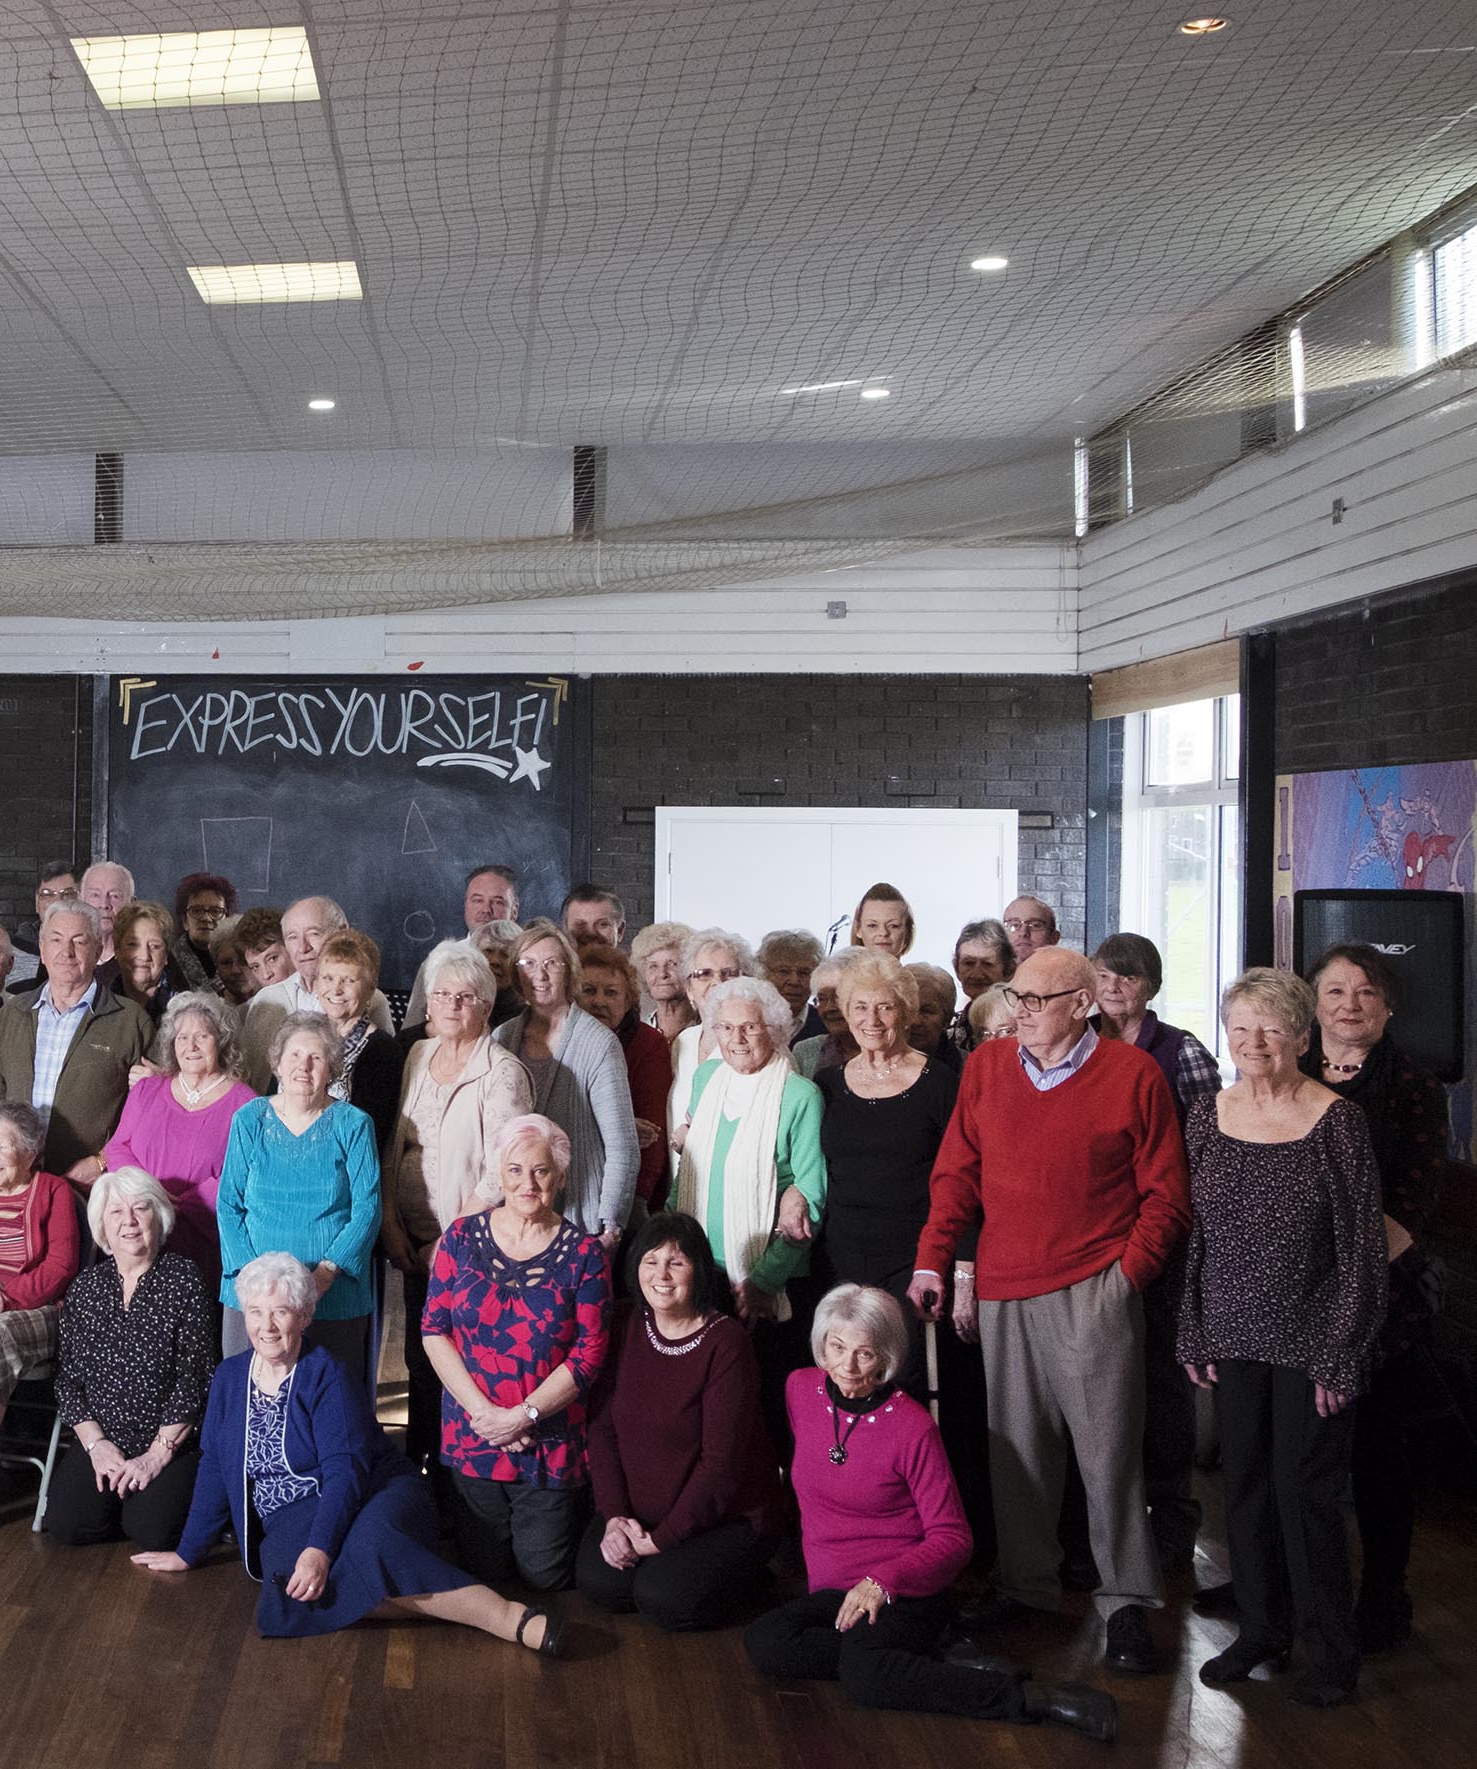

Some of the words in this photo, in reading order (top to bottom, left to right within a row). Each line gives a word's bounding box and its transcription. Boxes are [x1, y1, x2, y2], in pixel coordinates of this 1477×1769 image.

[130, 689, 325, 760] EXPRESS
[324, 687, 547, 757] YOURSELF!
[1370, 943, 1417, 955] AVEY
